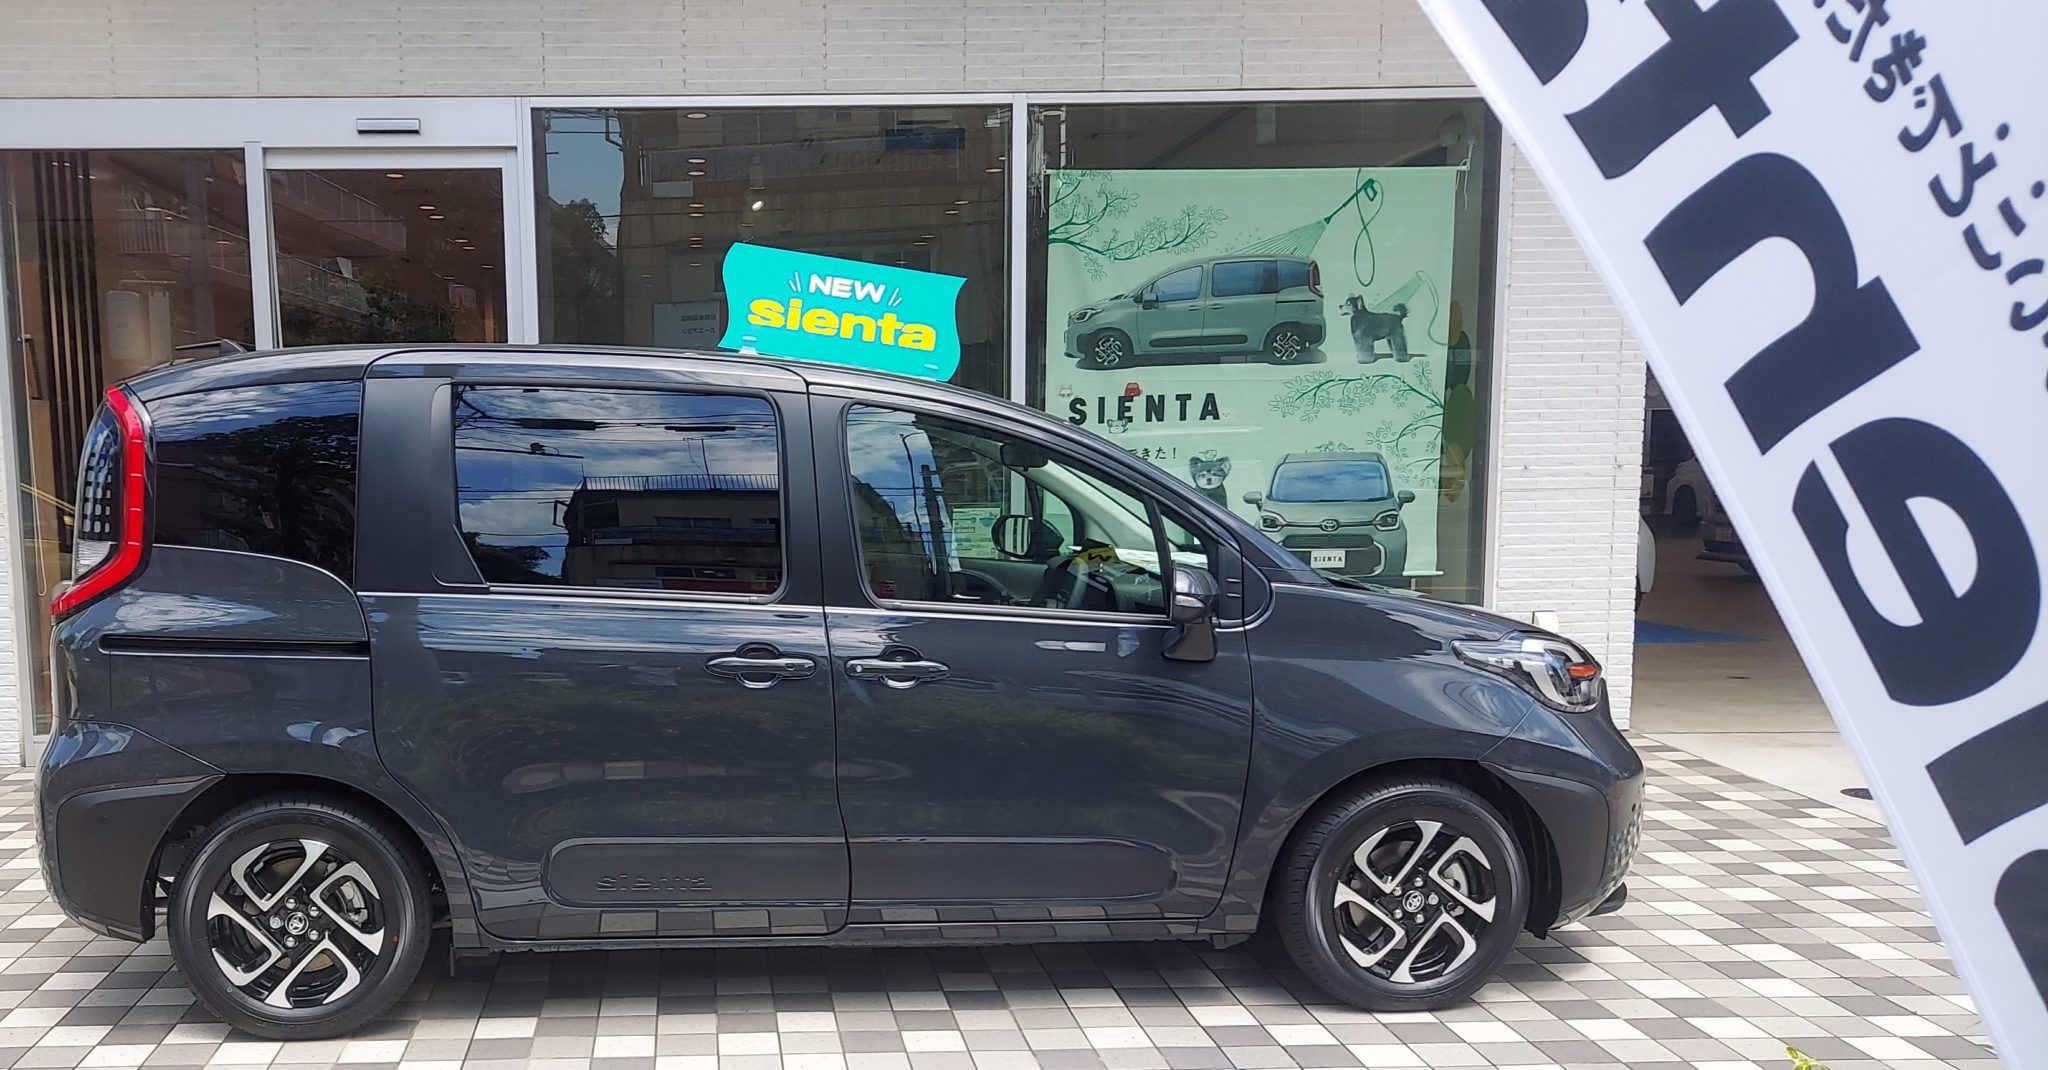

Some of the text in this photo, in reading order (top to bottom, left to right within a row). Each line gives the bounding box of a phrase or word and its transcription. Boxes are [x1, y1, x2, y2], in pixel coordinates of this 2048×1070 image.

[808, 273, 886, 304] NEW
[748, 298, 937, 352] sienta
[1068, 392, 1220, 426] SIENTA
[596, 873, 712, 891] sienta
